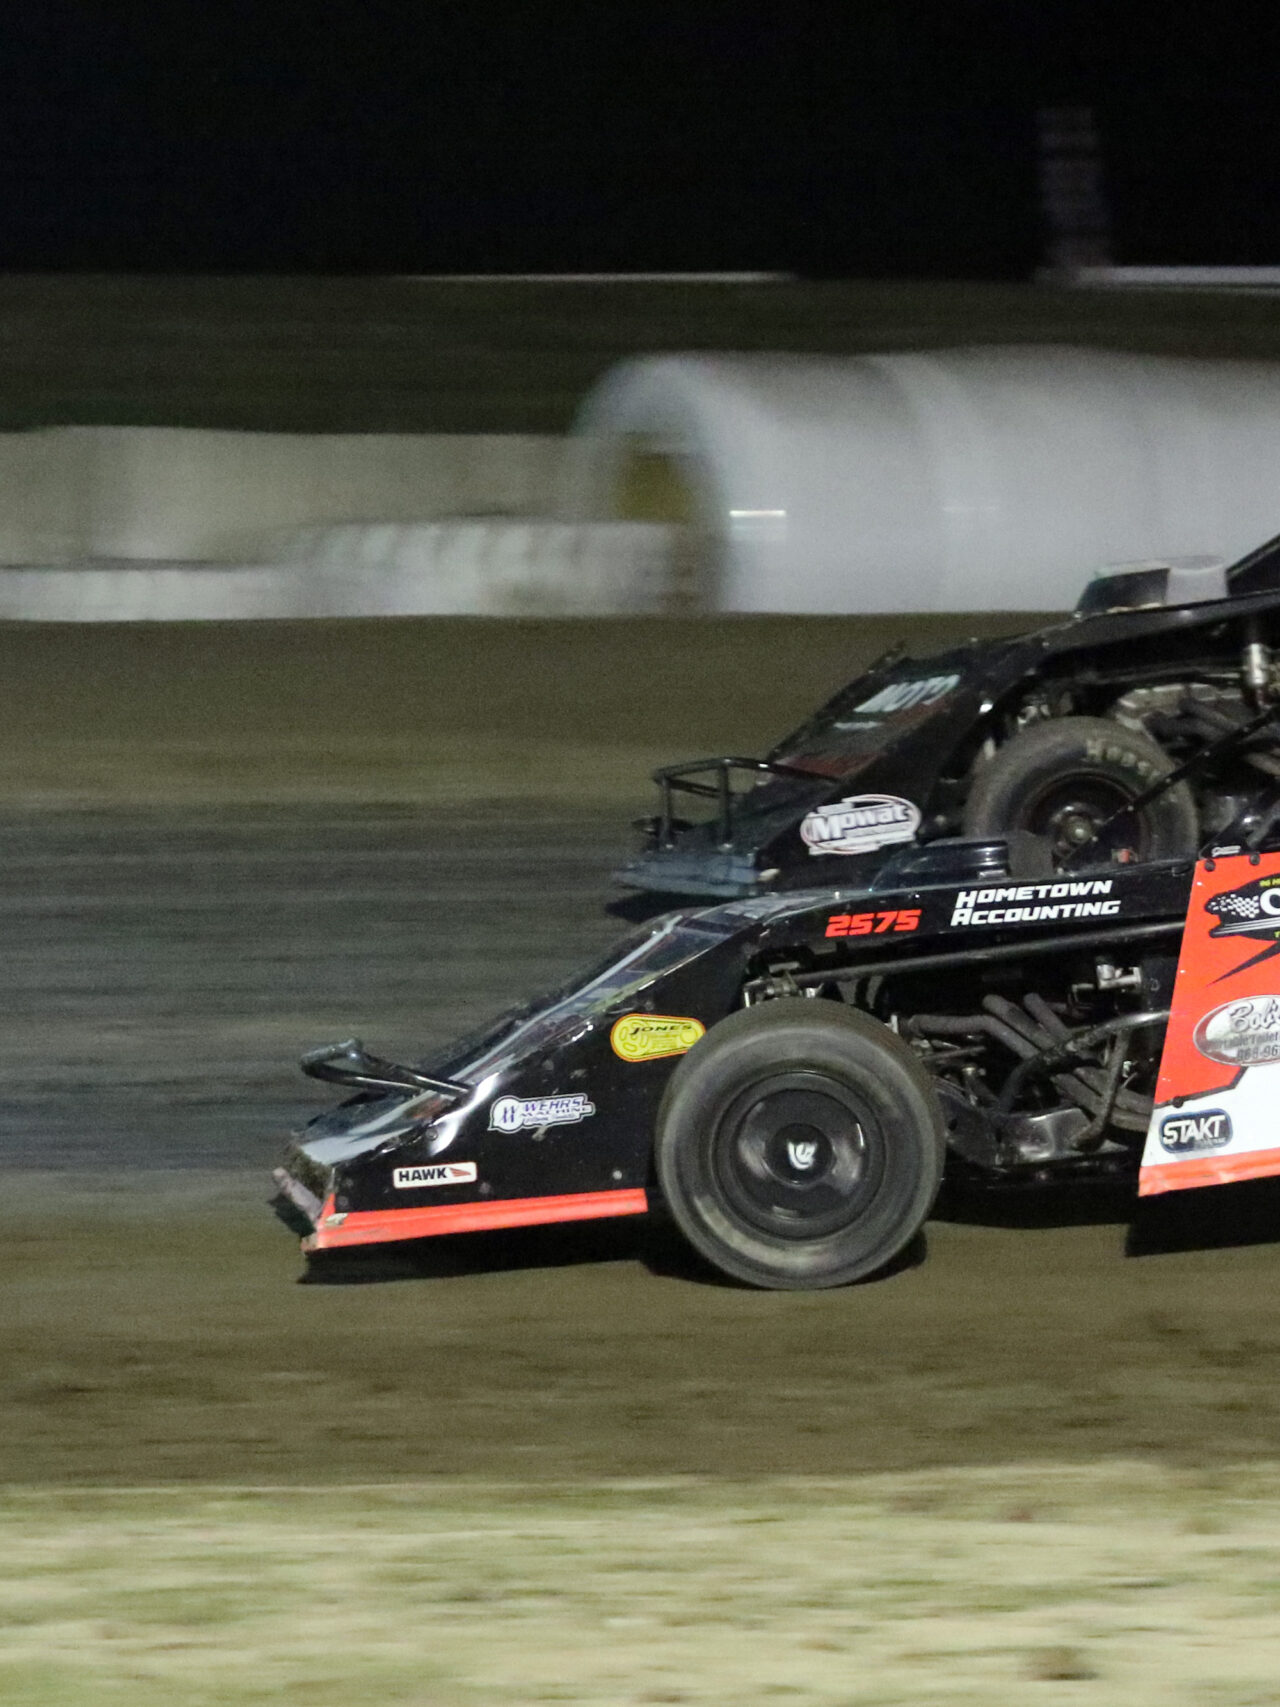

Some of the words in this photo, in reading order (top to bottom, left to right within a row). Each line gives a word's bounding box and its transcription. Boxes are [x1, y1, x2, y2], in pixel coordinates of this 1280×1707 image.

[956, 880, 1113, 909] HOMETOWN
[824, 909, 922, 938] 2575
[950, 900, 1122, 928] ACCOUNTING
[629, 1024, 693, 1036] JONES
[1162, 1113, 1227, 1146] STAKT
[398, 1166, 449, 1183] HAWK
